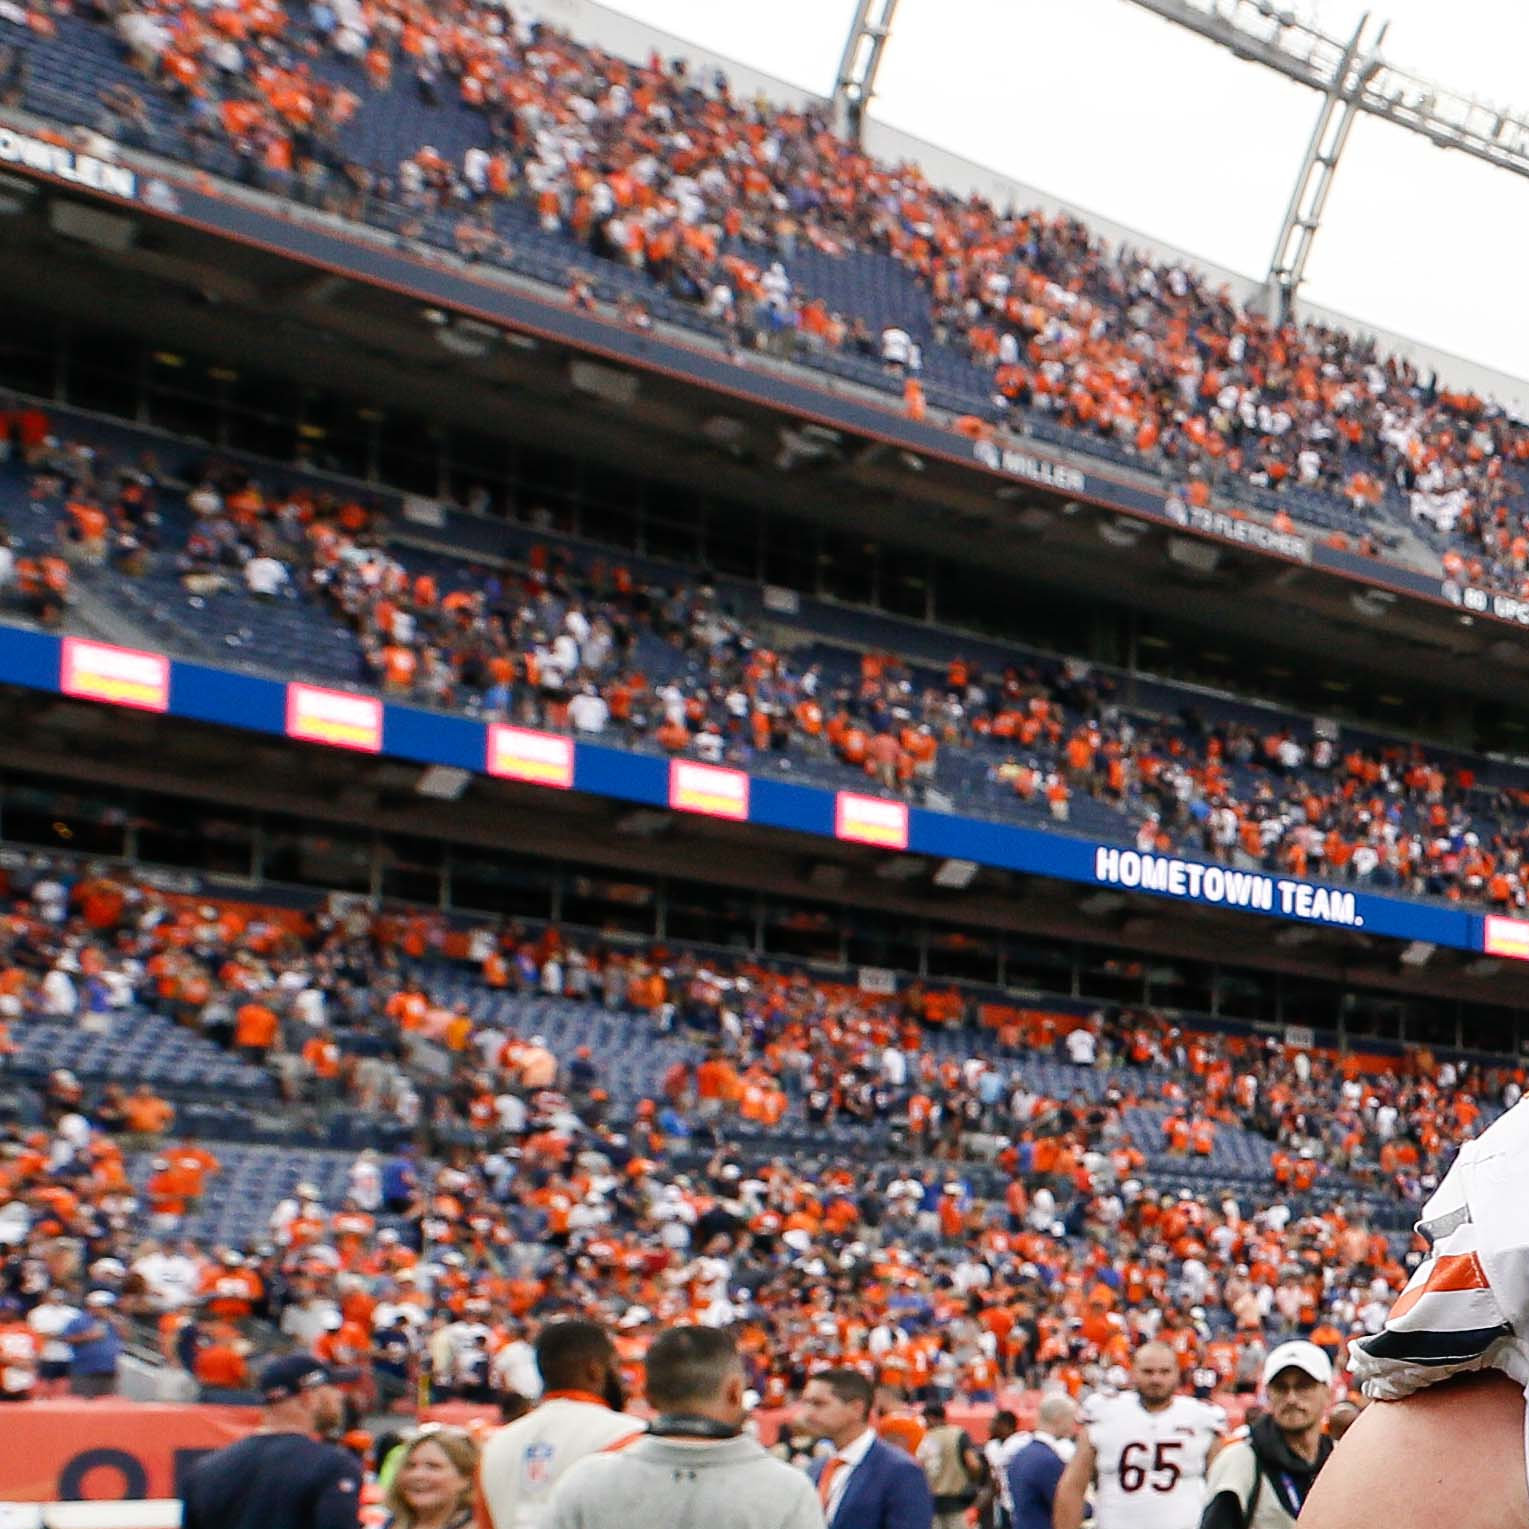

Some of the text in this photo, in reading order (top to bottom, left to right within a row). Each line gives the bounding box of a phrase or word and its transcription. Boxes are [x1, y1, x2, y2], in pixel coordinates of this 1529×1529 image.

[1002, 450, 1086, 492] MILLER
[1214, 512, 1312, 566] FLETCHER
[1096, 847, 1364, 927] HOMETOWN TEAM.
[1118, 1441, 1184, 1494] 65
